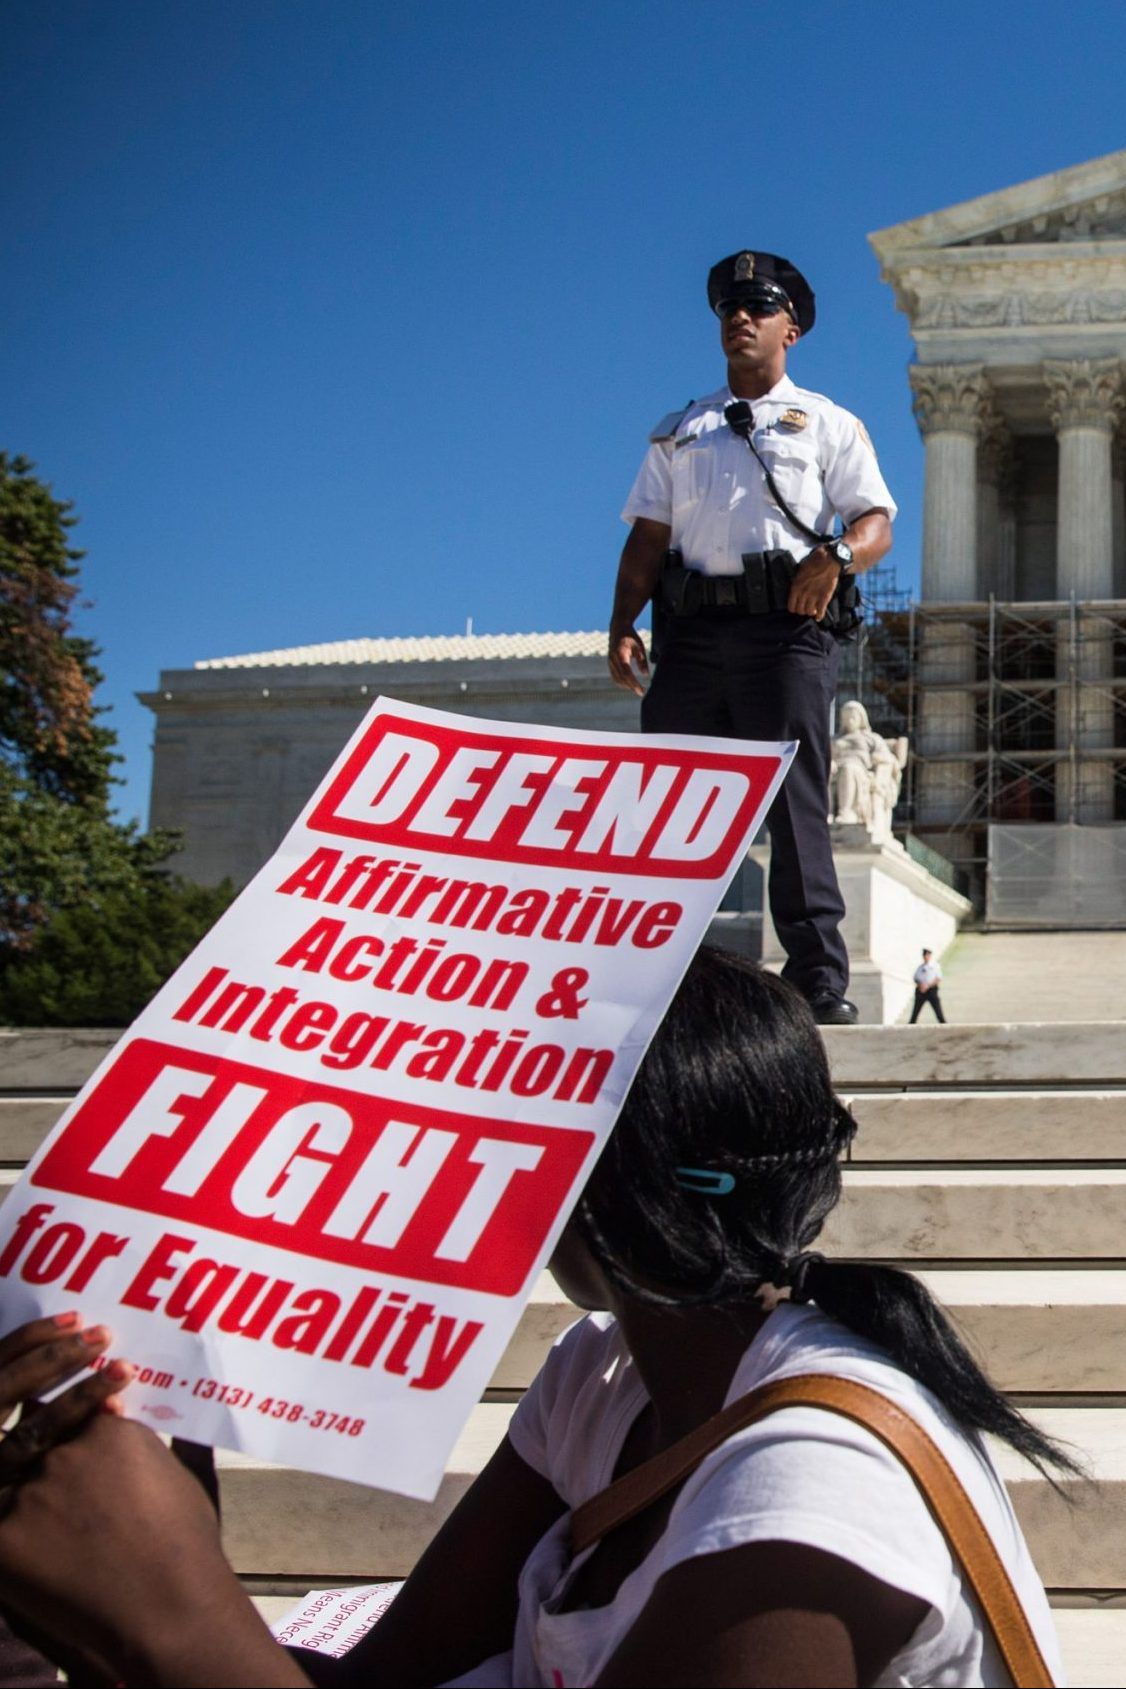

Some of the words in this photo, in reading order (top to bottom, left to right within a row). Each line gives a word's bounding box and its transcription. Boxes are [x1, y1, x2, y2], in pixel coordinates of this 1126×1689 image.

[333, 733, 750, 862] DEFEND
[275, 846, 684, 950] Affirmative
[276, 916, 529, 1010] Action
[536, 966, 590, 1020] &
[172, 965, 615, 1106] Integration
[88, 1064, 546, 1263] FIGHT
[0, 1203, 131, 1294] for
[120, 1234, 485, 1391] Equality
[192, 1377, 254, 1409] (313)
[257, 1397, 366, 1436] 438-3748
